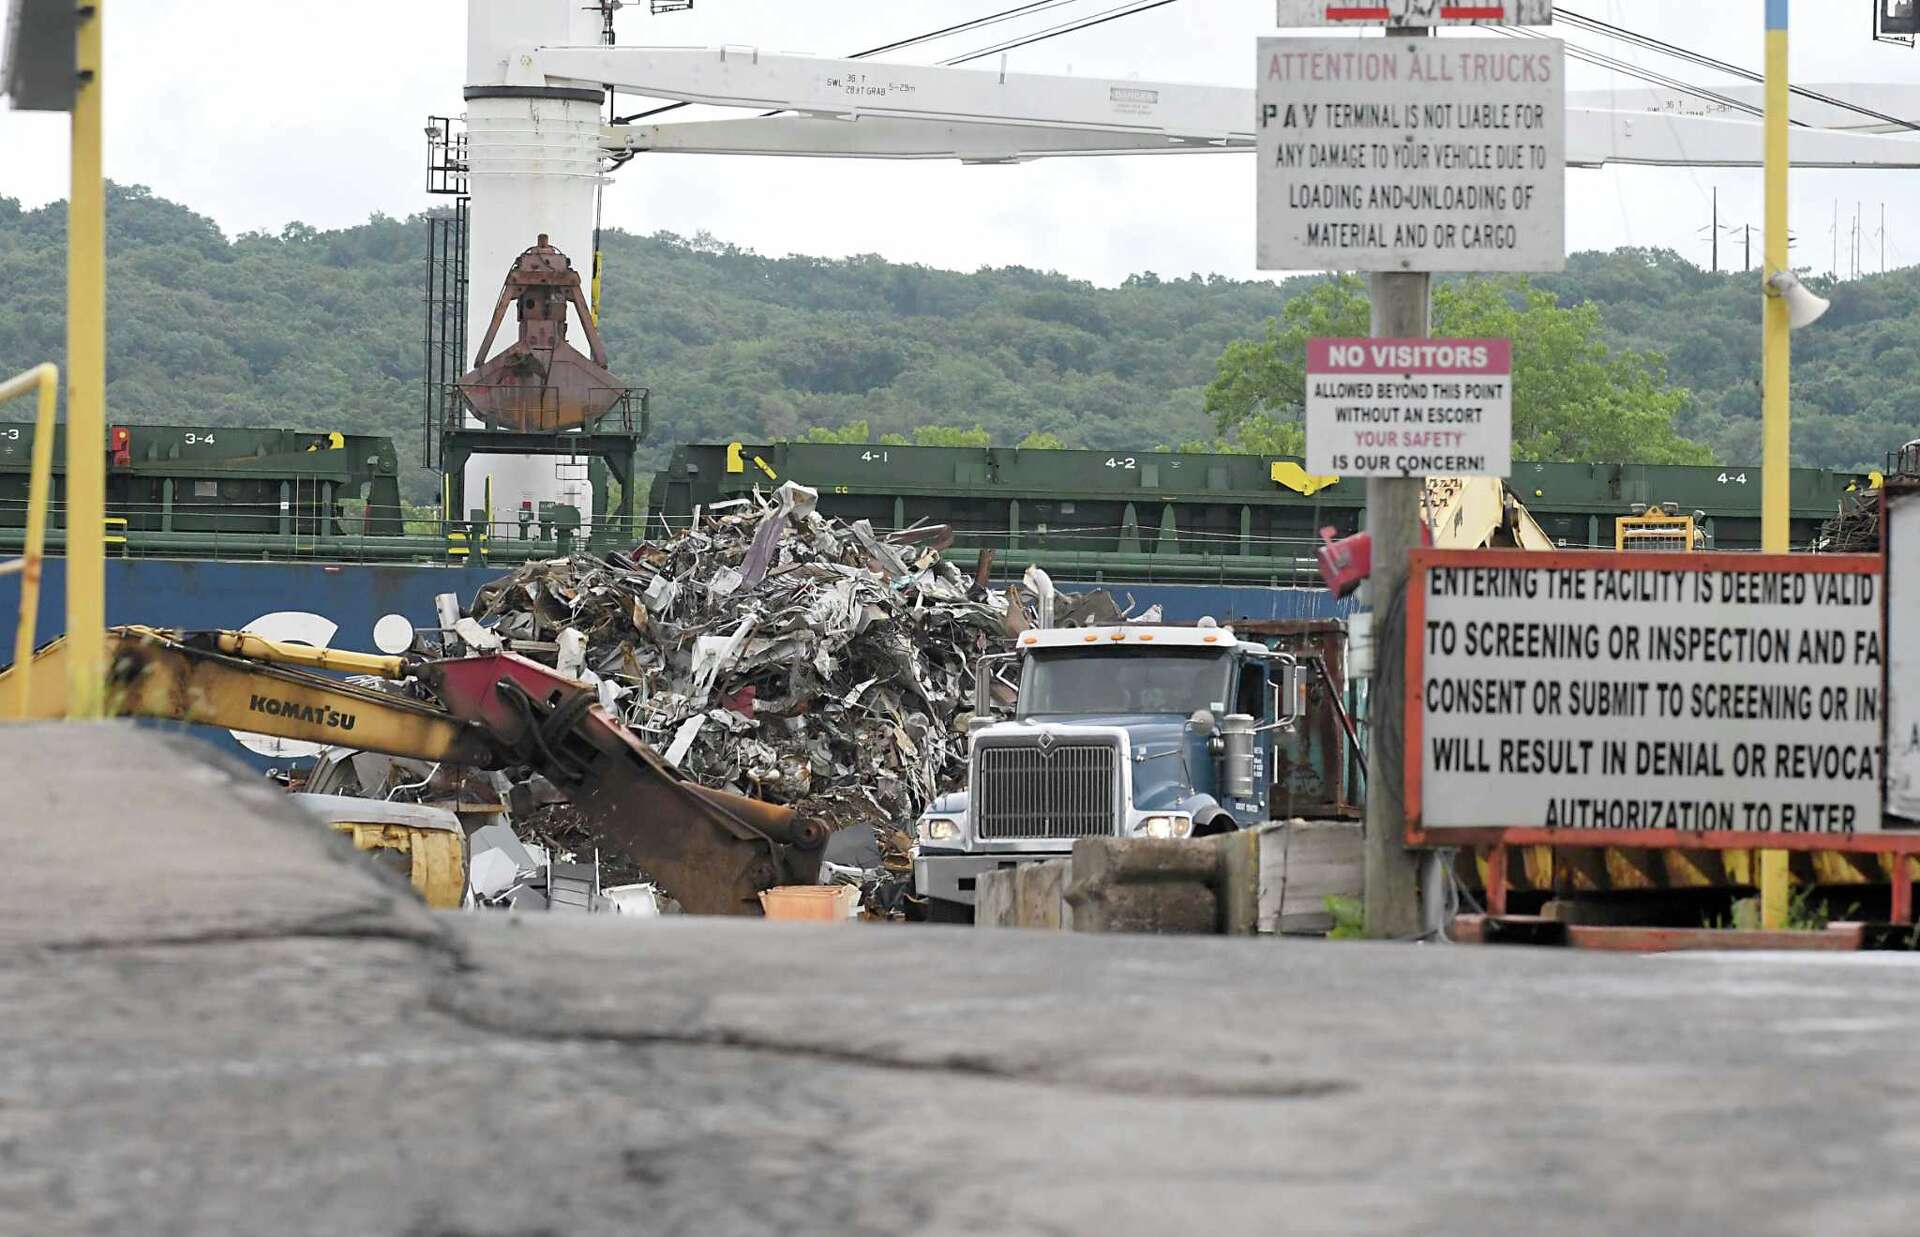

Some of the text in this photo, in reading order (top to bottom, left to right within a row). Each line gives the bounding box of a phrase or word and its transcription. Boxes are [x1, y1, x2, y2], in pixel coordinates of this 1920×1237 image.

[1268, 53, 1551, 83] ATTENTION ALL TRUCKS
[826, 78, 843, 87] SWL
[866, 87, 886, 96] GRAB
[1325, 104, 1399, 128] TERMINAL
[1405, 105, 1418, 129] IS
[1425, 104, 1452, 129] NOT
[1459, 105, 1509, 129] LIABLE
[1516, 104, 1543, 129] FOR
[1276, 144, 1545, 169] ANY DAMAGE TO YOUR VEHICLE DUE TO
[1290, 184, 1362, 209] LOADING
[1513, 185, 1534, 210] OF
[1308, 223, 1515, 249] MATERIAL AND OR CARGO
[1330, 346, 1487, 367] NO VISITORS
[1315, 383, 1503, 399] ALLOWED BEYOND THIS POINT
[1336, 407, 1482, 423] WITHOUT AN ESCORT
[185, 433, 215, 445] 3-4
[1355, 431, 1462, 447] YOUR SAFETY
[861, 451, 888, 463] 4-1
[1105, 457, 1136, 469] 4-2
[1333, 455, 1484, 472] IS OUR CONCERN!
[1717, 472, 1747, 484] 4-4
[1431, 569, 1874, 605] ENTERING THE FACILITY IS DEEMED VALID
[1428, 622, 1456, 655] TO
[1465, 622, 1599, 659] SCREENING
[1609, 625, 1639, 660] OR
[1649, 627, 1789, 663] INSPECTION
[1798, 630, 1845, 664] AND
[1426, 678, 1882, 721] CONSENT OR SUBMIT TO SCREENING OR IN
[249, 694, 356, 730] KOMATSU
[1433, 738, 1490, 772] WILL
[1500, 739, 1593, 774] RESULT
[1603, 741, 1626, 775] IN
[1637, 742, 1724, 776] DENIAL
[1733, 743, 1766, 777] OR
[1545, 798, 1856, 834] AUTHORIZATION TO ENTER
